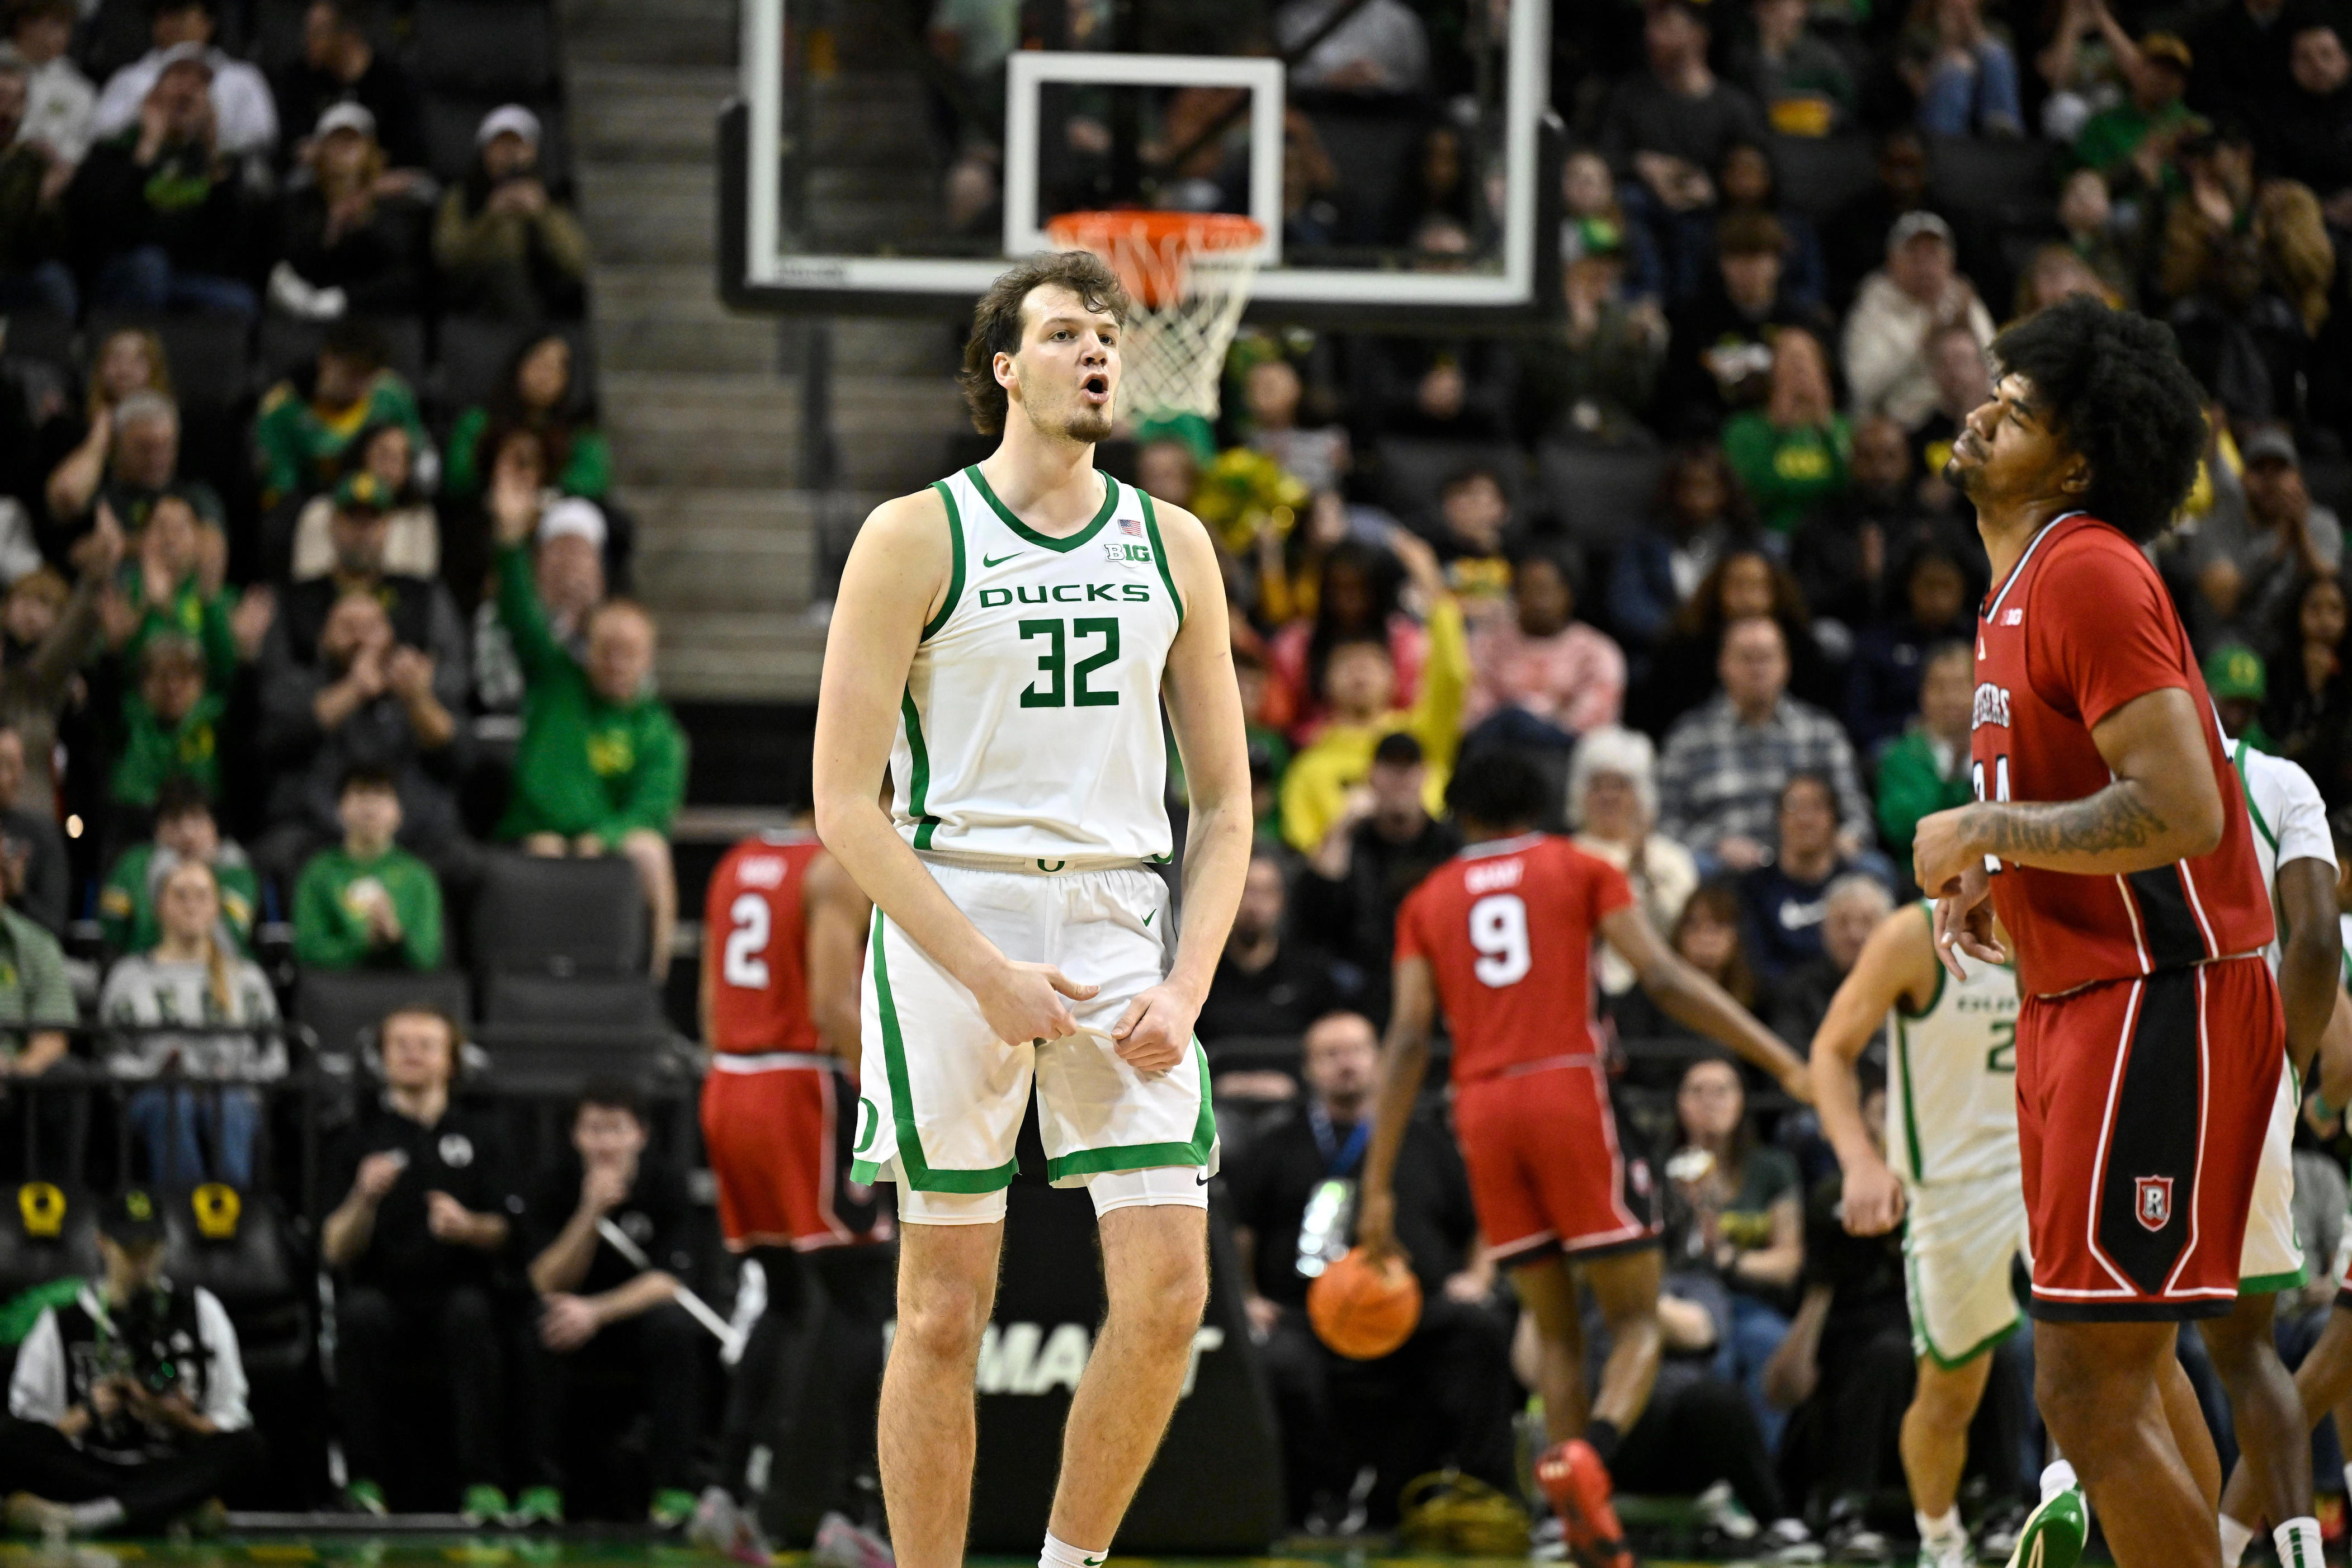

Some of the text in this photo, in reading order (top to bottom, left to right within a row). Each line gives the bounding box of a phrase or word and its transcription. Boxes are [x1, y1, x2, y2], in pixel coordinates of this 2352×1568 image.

[979, 584, 1150, 608] DUCKS
[1018, 617, 1120, 708] 32
[723, 892, 772, 990] 2
[1468, 893, 1532, 989] 9
[2144, 1186, 2166, 1219] R
